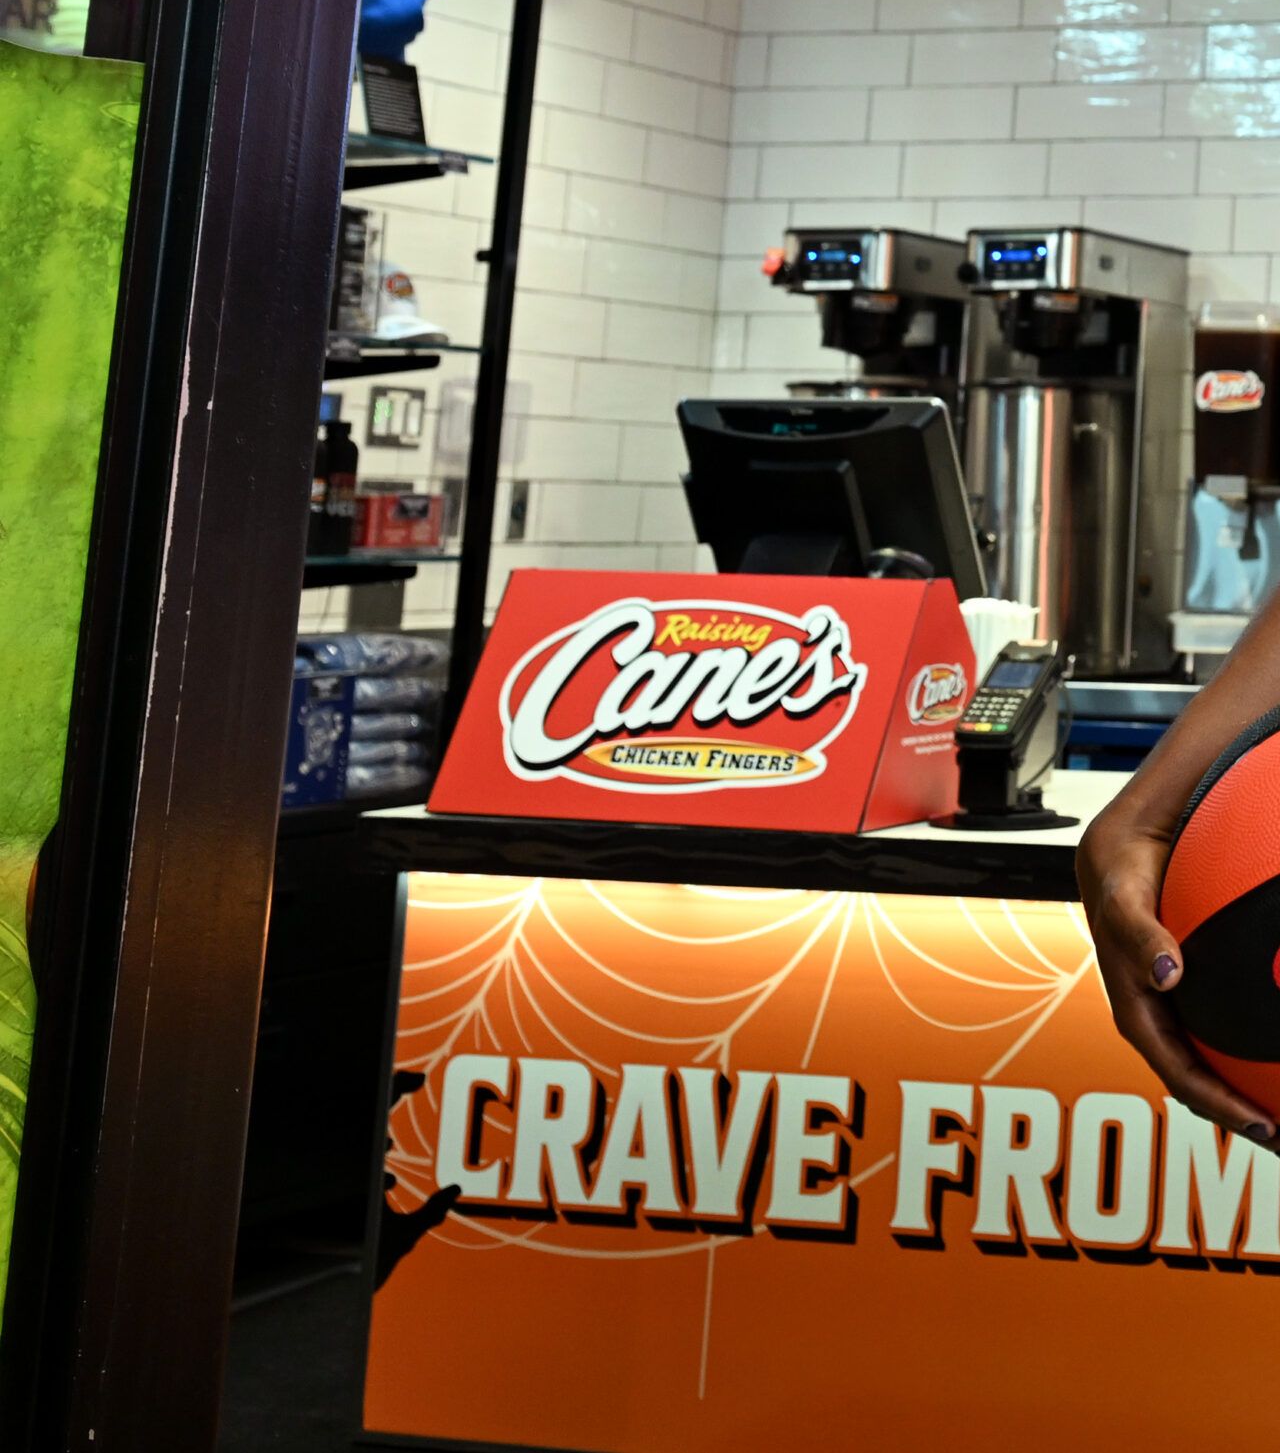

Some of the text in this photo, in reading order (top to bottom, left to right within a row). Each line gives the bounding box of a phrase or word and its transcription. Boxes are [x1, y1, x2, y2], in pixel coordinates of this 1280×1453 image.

[655, 614, 773, 650] Raising
[511, 603, 858, 768] Cane's
[610, 745, 798, 773] CHICKEN FINGERS
[435, 1052, 855, 1236] CRAVE
